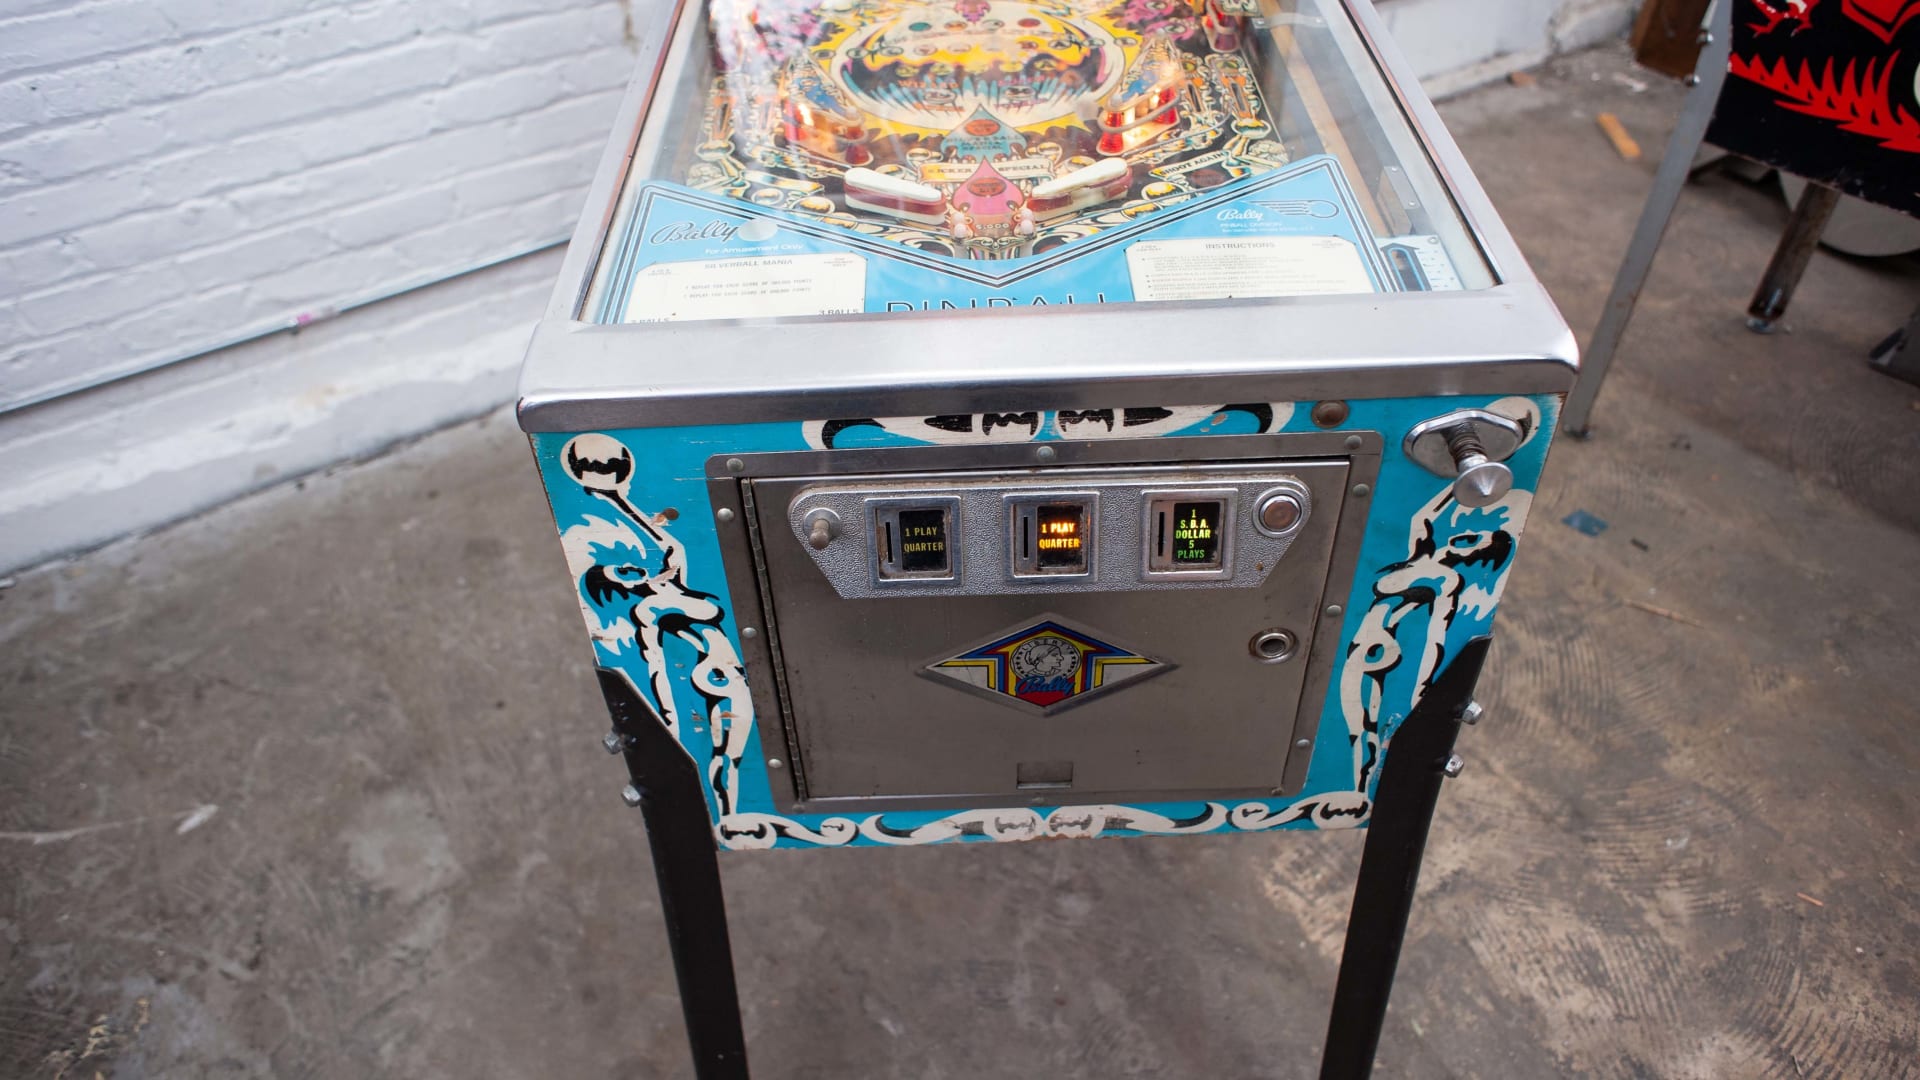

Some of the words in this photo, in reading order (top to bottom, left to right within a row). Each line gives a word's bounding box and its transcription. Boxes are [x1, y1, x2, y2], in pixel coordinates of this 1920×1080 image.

[1216, 208, 1264, 222] Bally
[650, 220, 739, 245] Bally
[722, 245, 779, 254] Amusement
[1191, 509, 1197, 518] 1
[904, 527, 911, 537] 1
[914, 526, 937, 536] PLAY
[1041, 523, 1047, 533] 1
[1050, 522, 1075, 533] PLAY
[1175, 529, 1211, 539] DOLLAR
[903, 541, 944, 552] QUARTER
[1039, 538, 1080, 549] QUARTER
[1188, 539, 1195, 549] 5
[1177, 549, 1205, 559] PLAYS
[1015, 675, 1076, 695] Bally
